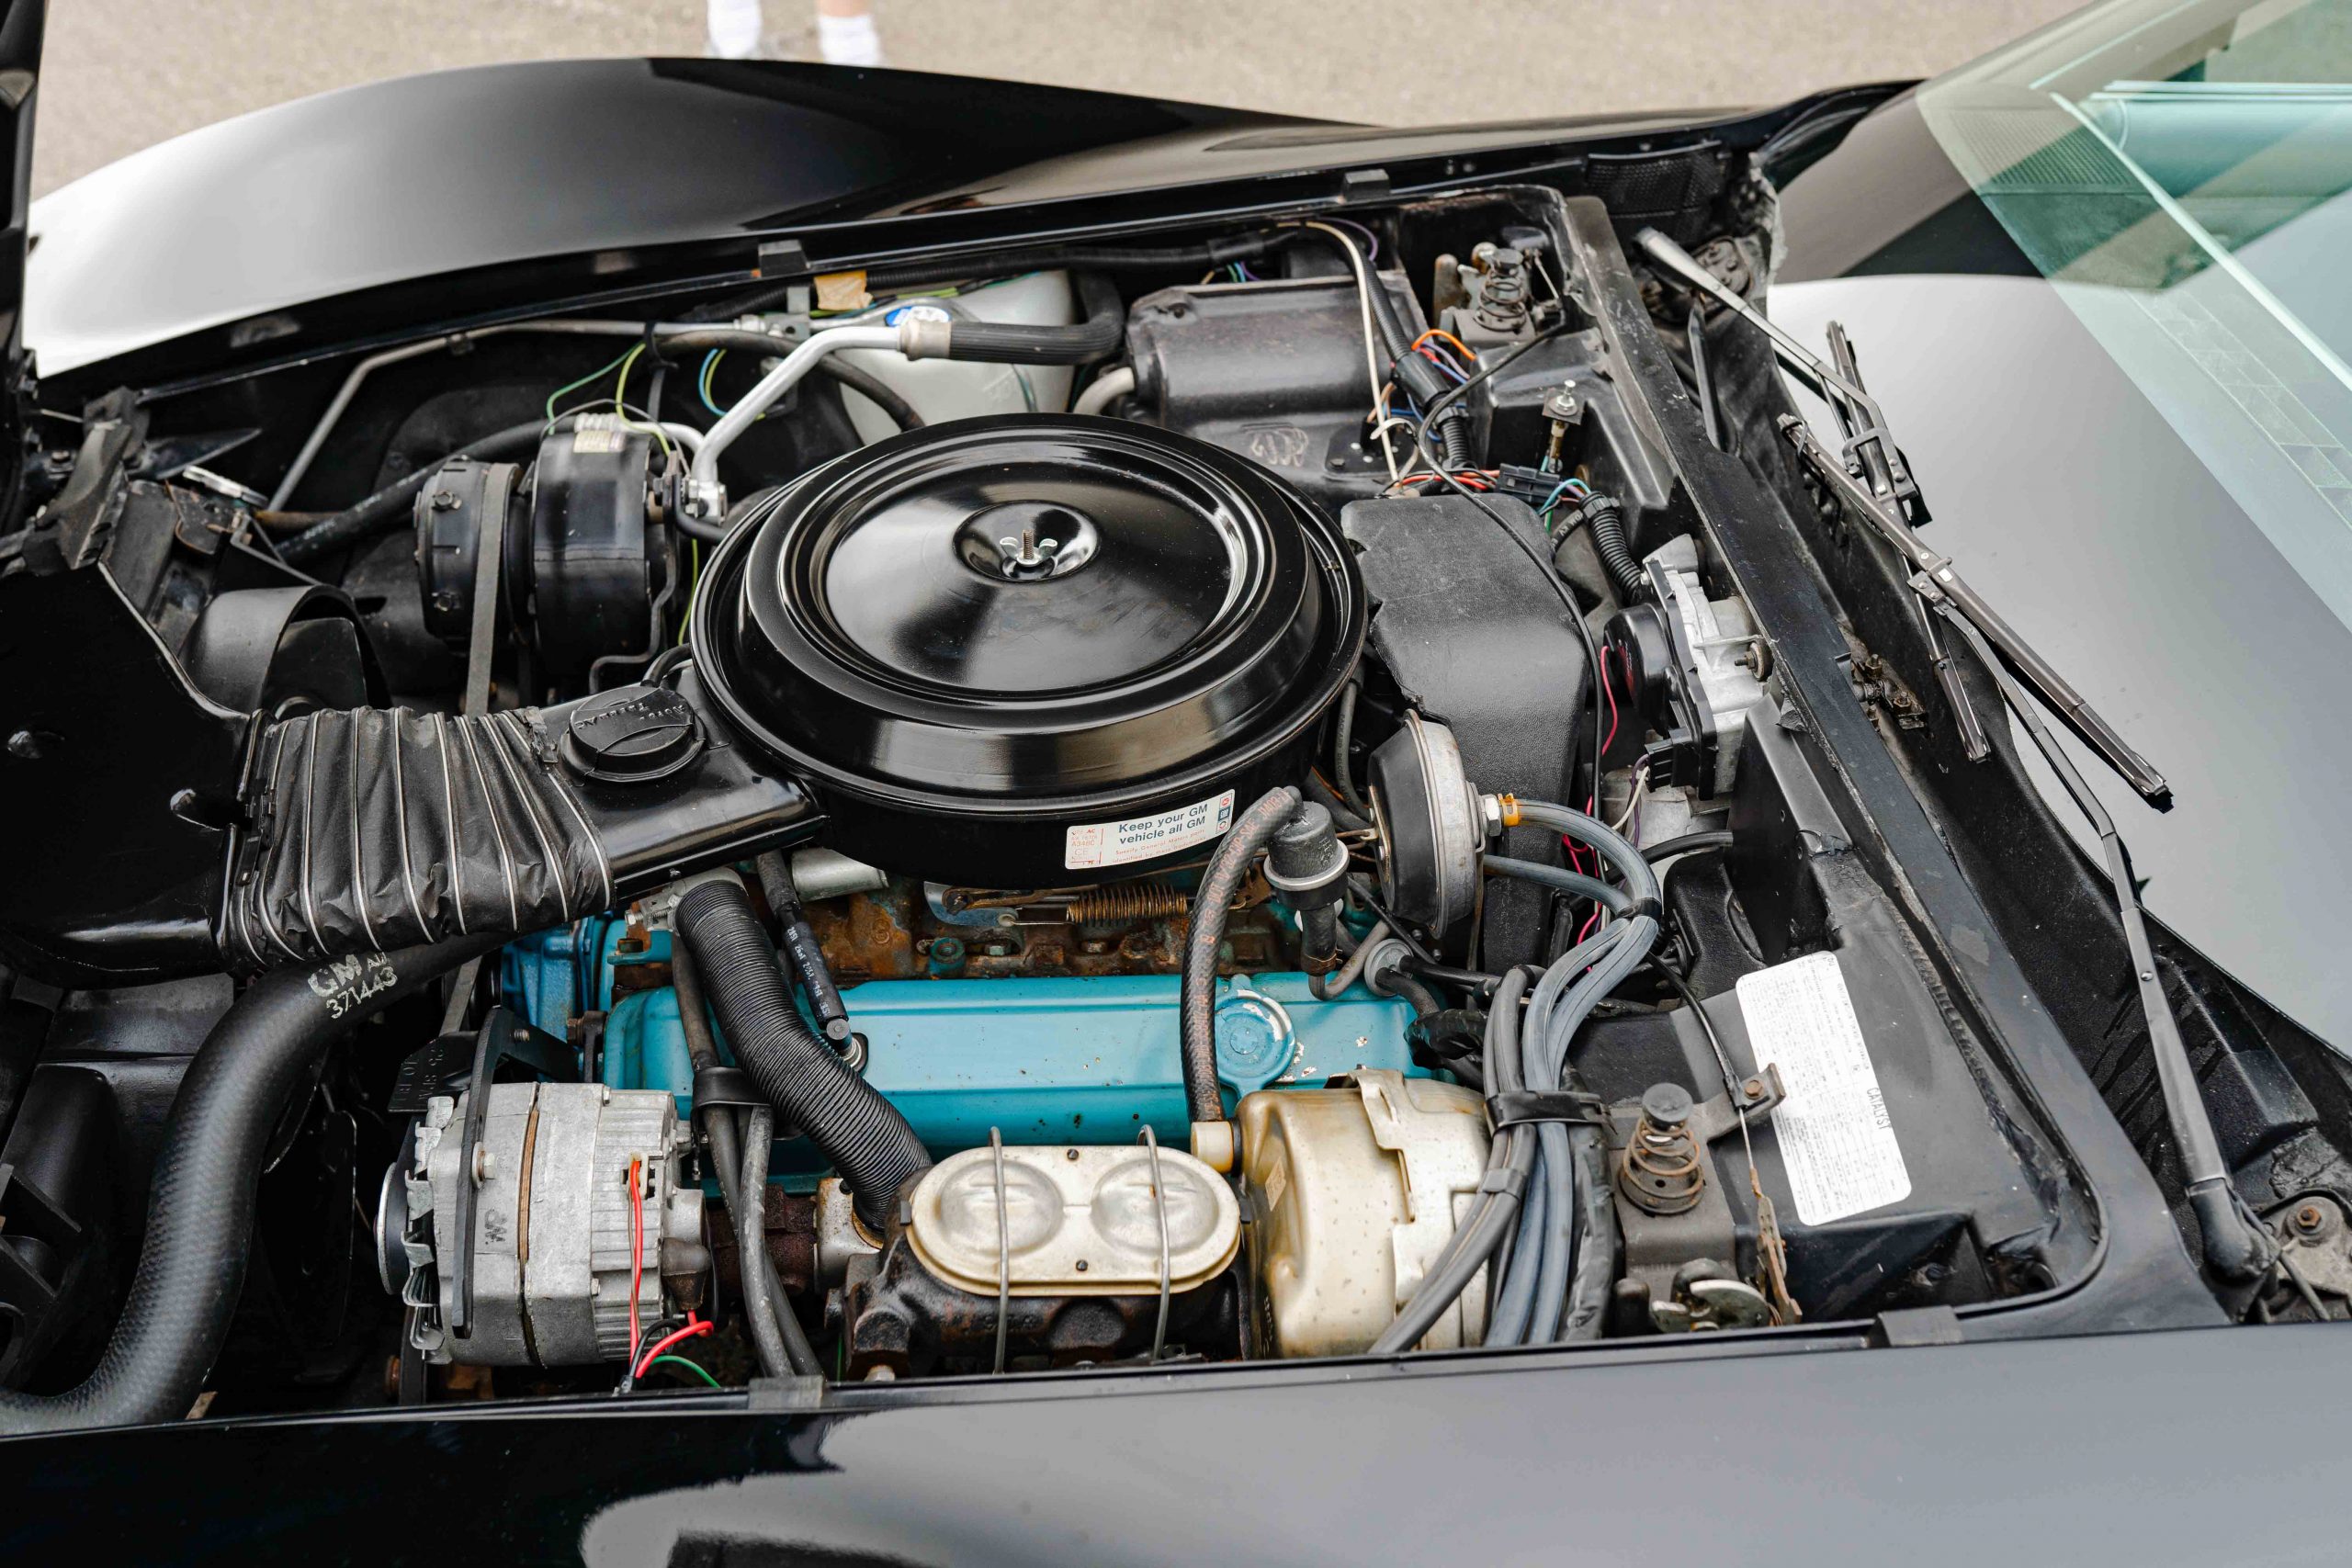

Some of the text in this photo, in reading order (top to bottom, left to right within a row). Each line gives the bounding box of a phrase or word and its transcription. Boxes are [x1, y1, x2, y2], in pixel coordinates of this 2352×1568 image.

[1118, 804, 1208, 833] Keep your GM
[1120, 816, 1205, 844] vehicle all GM
[1140, 840, 1166, 851] General
[1168, 835, 1188, 843] Motors
[307, 953, 363, 998] GM
[1866, 1087, 1893, 1131] CATALYST
